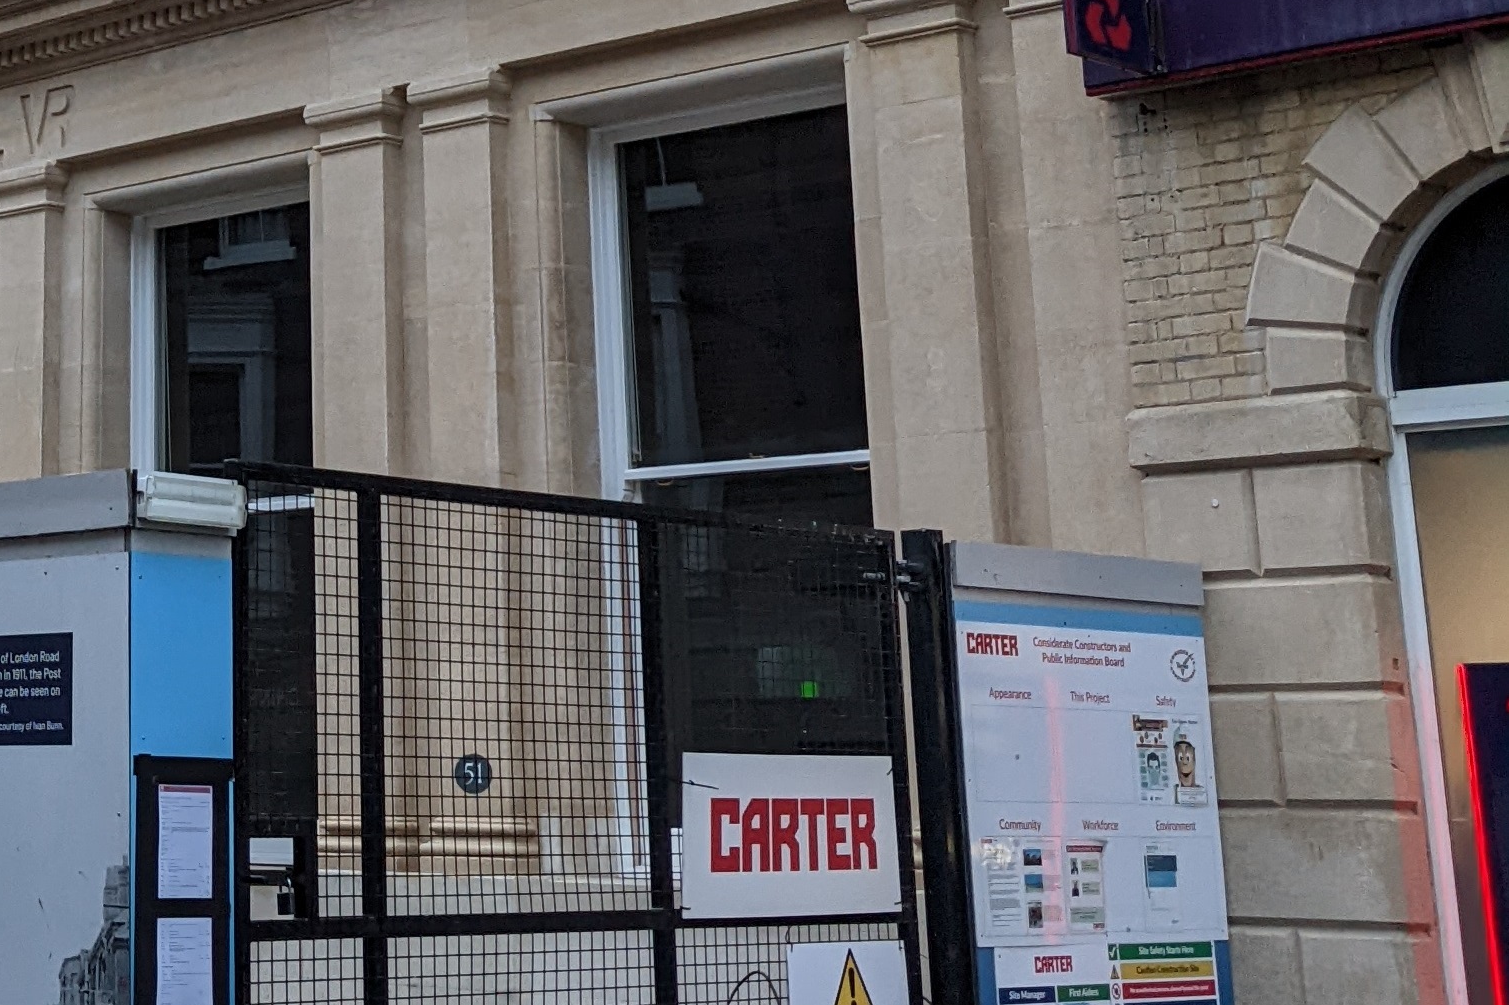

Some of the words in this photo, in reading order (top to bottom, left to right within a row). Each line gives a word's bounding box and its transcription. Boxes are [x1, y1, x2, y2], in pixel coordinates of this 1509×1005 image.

[966, 632, 1019, 657] CARTER
[1033, 636, 1074, 650] Considerate
[1074, 639, 1118, 652] Constructors
[1118, 642, 1131, 653] and
[0, 652, 9, 664] of
[10, 651, 39, 664] London
[40, 650, 60, 663] Road
[1042, 652, 1063, 664] Public
[1064, 653, 1103, 666] Information
[1104, 655, 1125, 667] Board
[3, 668, 11, 680] in
[29, 668, 42, 680] the
[43, 667, 61, 680] Post
[4, 688, 19, 698] can
[19, 686, 29, 697] be
[30, 687, 50, 697] seen
[50, 687, 61, 697] on
[989, 686, 1032, 701] Appearance
[1069, 691, 1085, 702] This
[1085, 692, 1110, 705] Project
[1155, 695, 1178, 708] Safety
[464, 762, 483, 785] 51
[998, 818, 1041, 832] Community
[1081, 819, 1119, 831] Workforce
[1155, 819, 1197, 832] Environment
[710, 797, 878, 873] CARTER
[1034, 955, 1073, 974] CARTER
